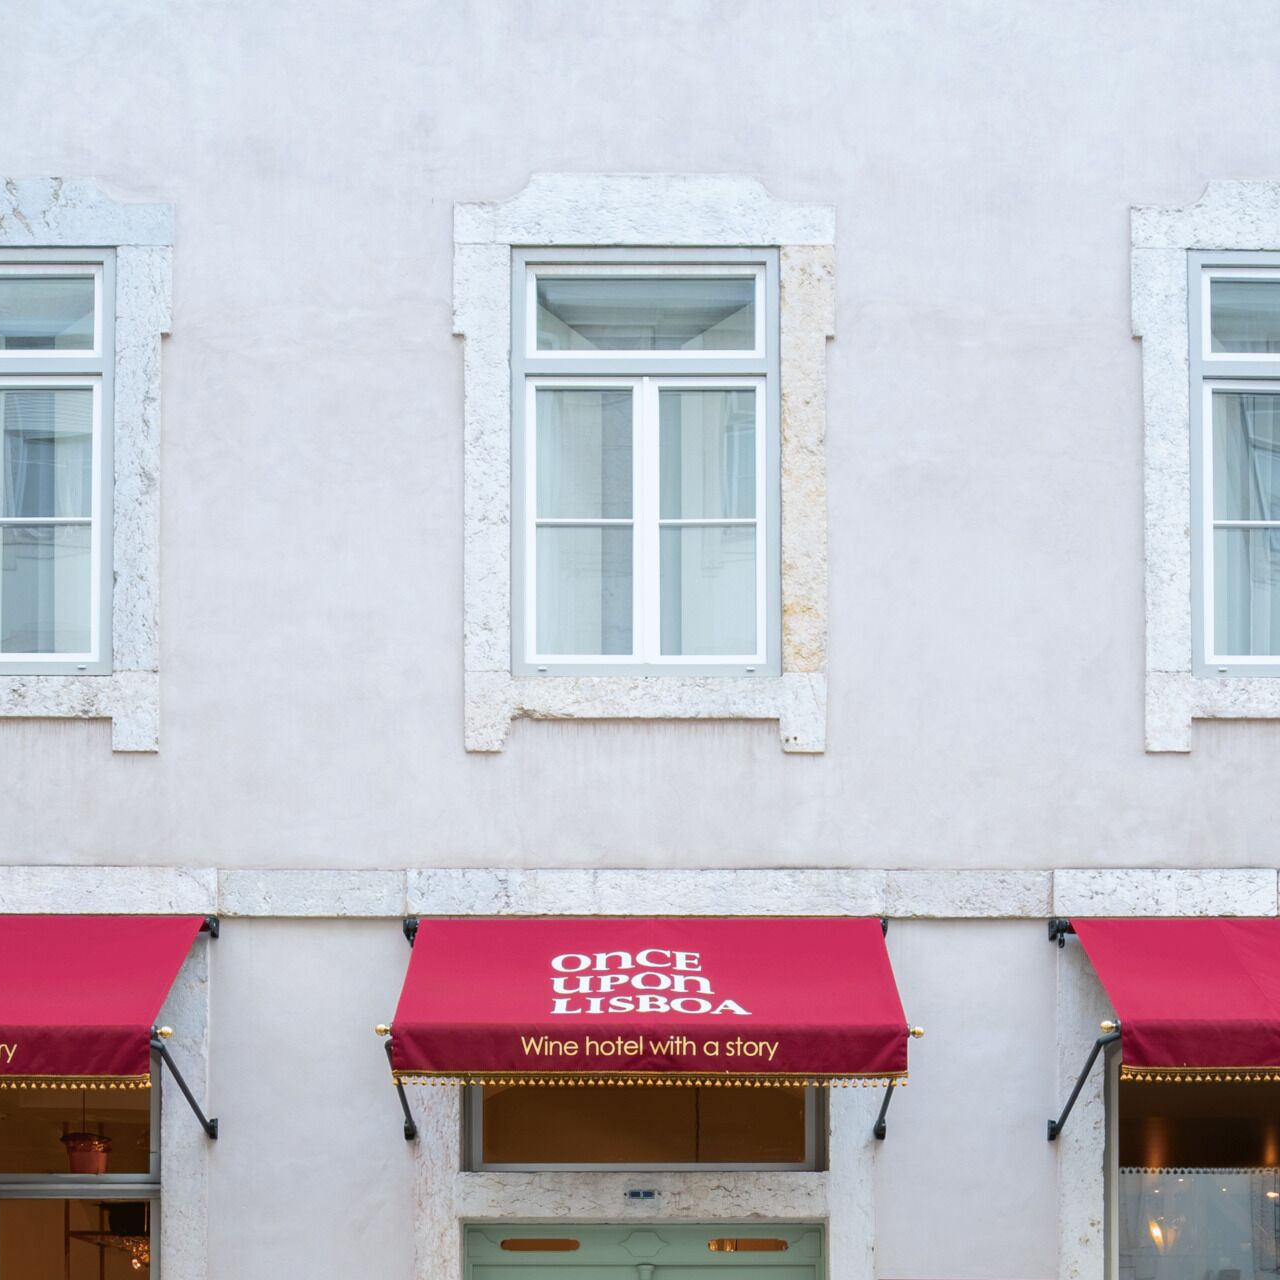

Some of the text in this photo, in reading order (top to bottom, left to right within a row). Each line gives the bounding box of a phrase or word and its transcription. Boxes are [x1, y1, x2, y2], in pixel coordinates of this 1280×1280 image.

[551, 996, 752, 1016] LISBOA
[521, 1036, 779, 1062] Wine hotel with a story
